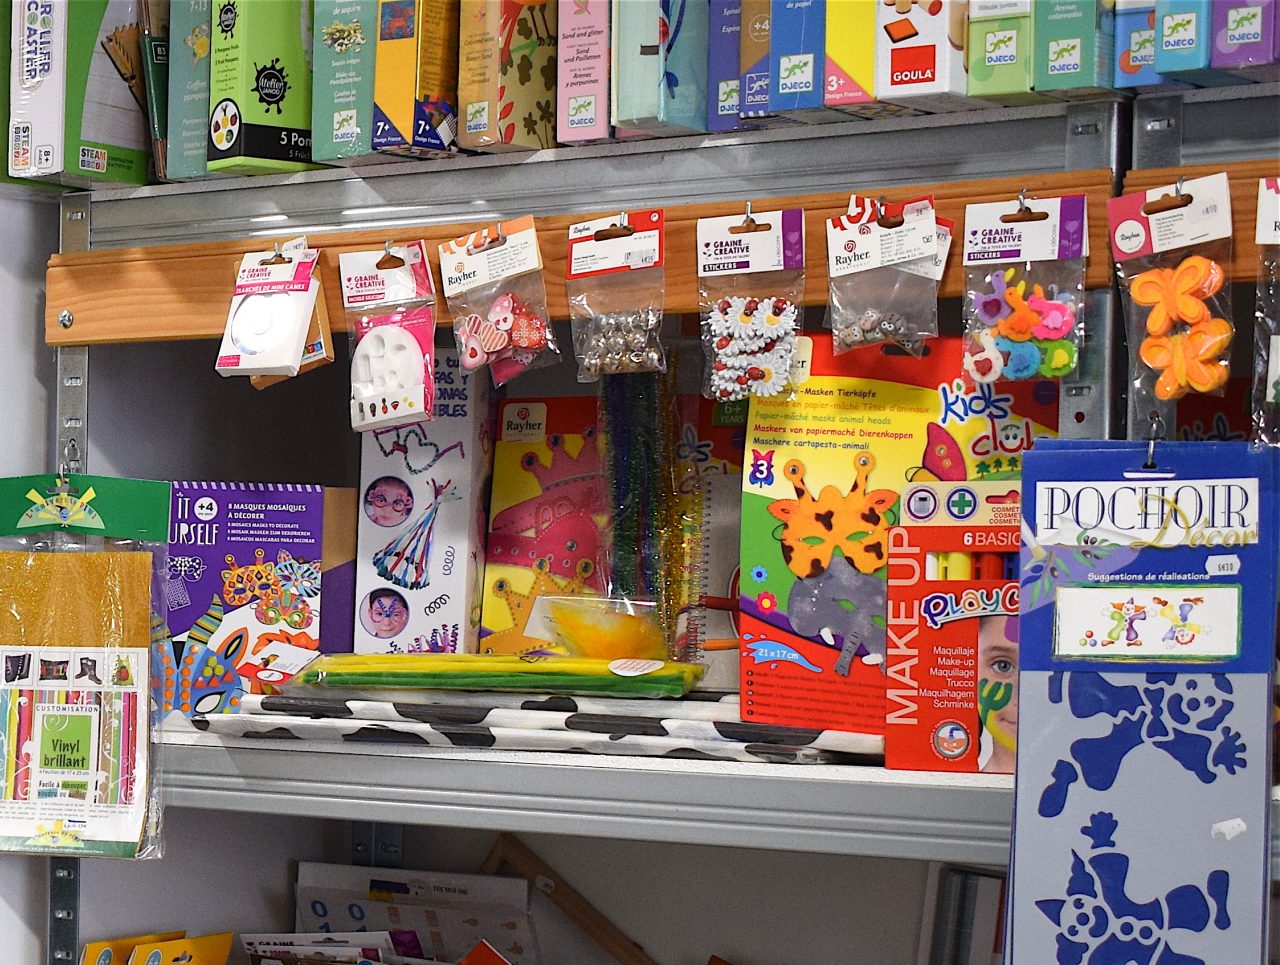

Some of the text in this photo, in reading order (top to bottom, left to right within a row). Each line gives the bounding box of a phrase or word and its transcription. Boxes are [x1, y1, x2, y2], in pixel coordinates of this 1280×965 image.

[1164, 37, 1195, 48] DJECO
[1228, 32, 1261, 42] DJECO
[987, 54, 1016, 64] DJECO
[1050, 63, 1079, 73] DJECO
[893, 70, 933, 82] GOULA
[781, 80, 812, 90] DJECO
[827, 75, 845, 91] 3+
[467, 122, 488, 132] DJECO
[570, 117, 595, 126] DJECO
[376, 121, 390, 136] 7+
[418, 120, 430, 135] 7+
[280, 130, 287, 145] 5
[21, 125, 30, 167] STEAM
[81, 147, 107, 160] STEAM
[981, 227, 1014, 236] GRAINE
[713, 239, 743, 248] GRAINE
[981, 233, 1022, 243] CREATIVE
[713, 246, 750, 255] CREATIVE
[969, 251, 1001, 260] STICKERS
[835, 250, 870, 266] Rayher
[704, 262, 738, 271] STICKERS
[354, 274, 379, 282] GRAINE
[447, 269, 477, 286] Rayher
[355, 280, 385, 288] CREATIVE
[506, 419, 542, 434] Rayher
[753, 424, 786, 433] Maskers
[790, 426, 803, 434] van
[859, 429, 913, 440] Dierenkoppen
[753, 437, 790, 446] Maschere
[755, 460, 768, 479] 3
[198, 502, 213, 512] +4
[234, 503, 266, 511] MASQUES
[1043, 483, 1251, 531] POCHOIR
[1129, 493, 1258, 549] Décor
[963, 533, 973, 545] 6
[1087, 571, 1211, 583] Suggestions de réalisations
[886, 528, 920, 724] MAKE UP
[933, 645, 975, 657] Maquillaje
[938, 656, 974, 668] Make-up
[930, 667, 975, 679] Maquillage
[946, 678, 974, 688] Trucco
[919, 688, 975, 699] Maquilhagem
[36, 705, 99, 713] CUSTOMISATION
[933, 698, 974, 709] Schminke
[52, 739, 80, 754] Vinyl
[44, 754, 86, 768] brillant
